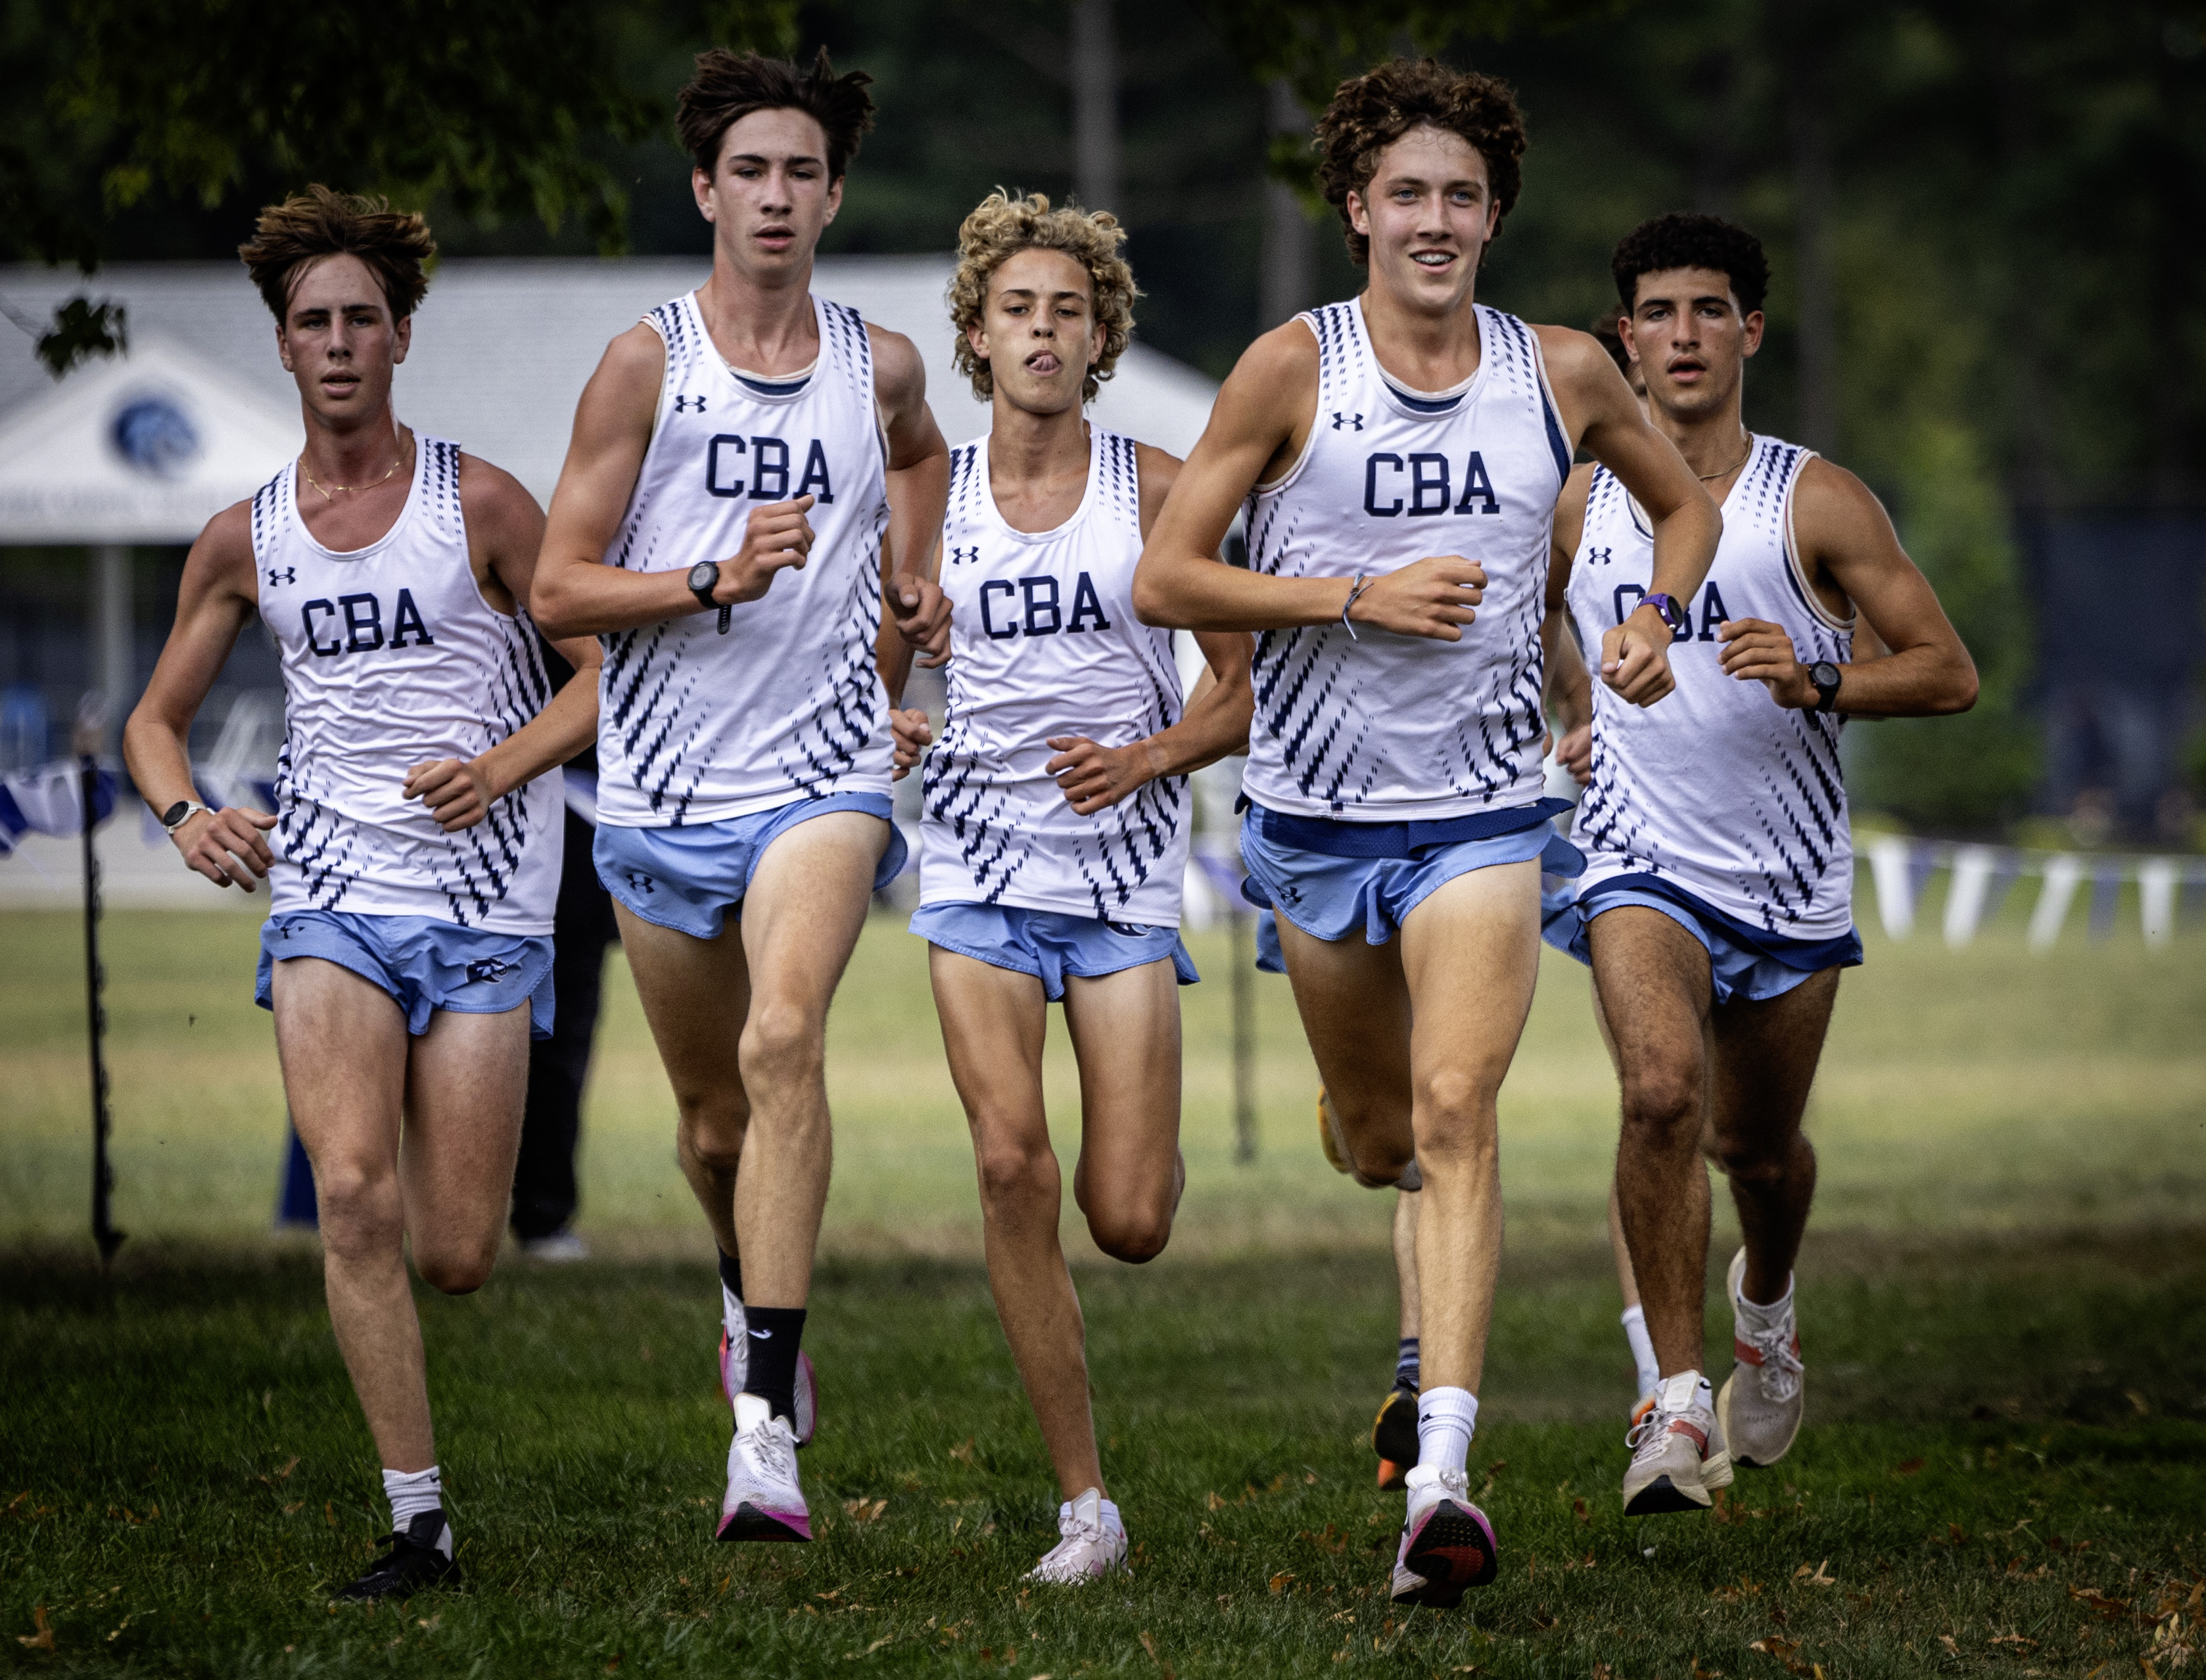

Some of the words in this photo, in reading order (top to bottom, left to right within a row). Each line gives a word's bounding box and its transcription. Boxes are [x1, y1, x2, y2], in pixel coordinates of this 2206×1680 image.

[706, 434, 835, 505] CBA
[1363, 452, 1500, 518] CBA
[302, 588, 434, 657] CBA
[979, 572, 1112, 641] CBA
[1613, 581, 1730, 643] CA
